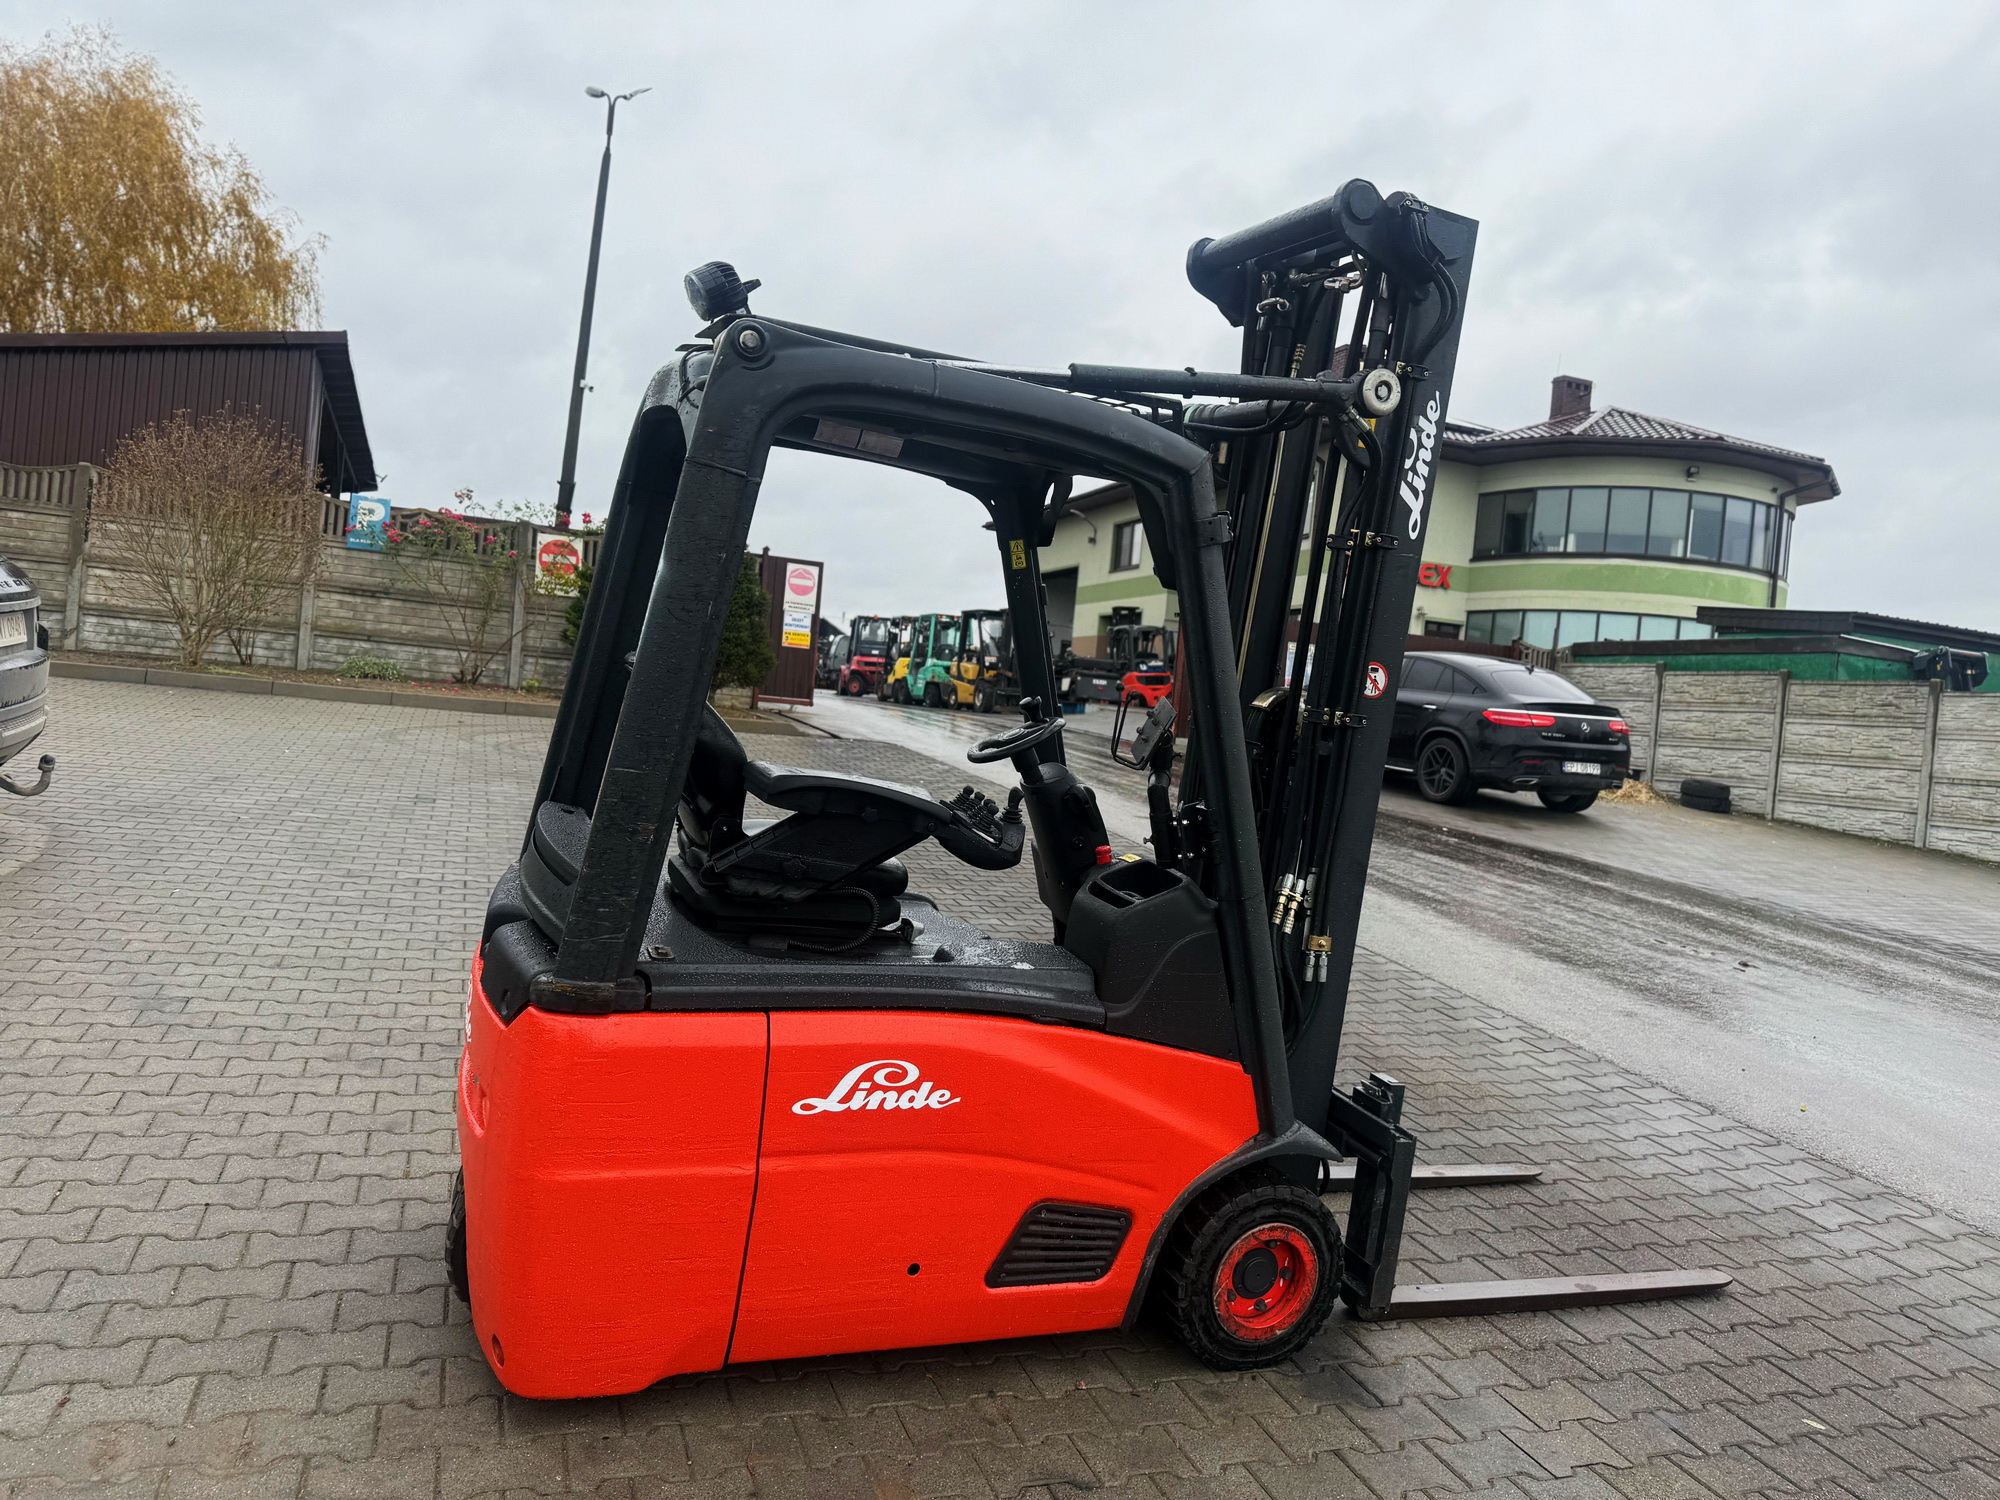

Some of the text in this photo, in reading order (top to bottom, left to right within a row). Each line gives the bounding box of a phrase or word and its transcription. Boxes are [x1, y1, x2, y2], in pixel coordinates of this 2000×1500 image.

[1400, 391, 1440, 540] Linde
[356, 500, 385, 530] P
[791, 1059, 962, 1115] Linde
